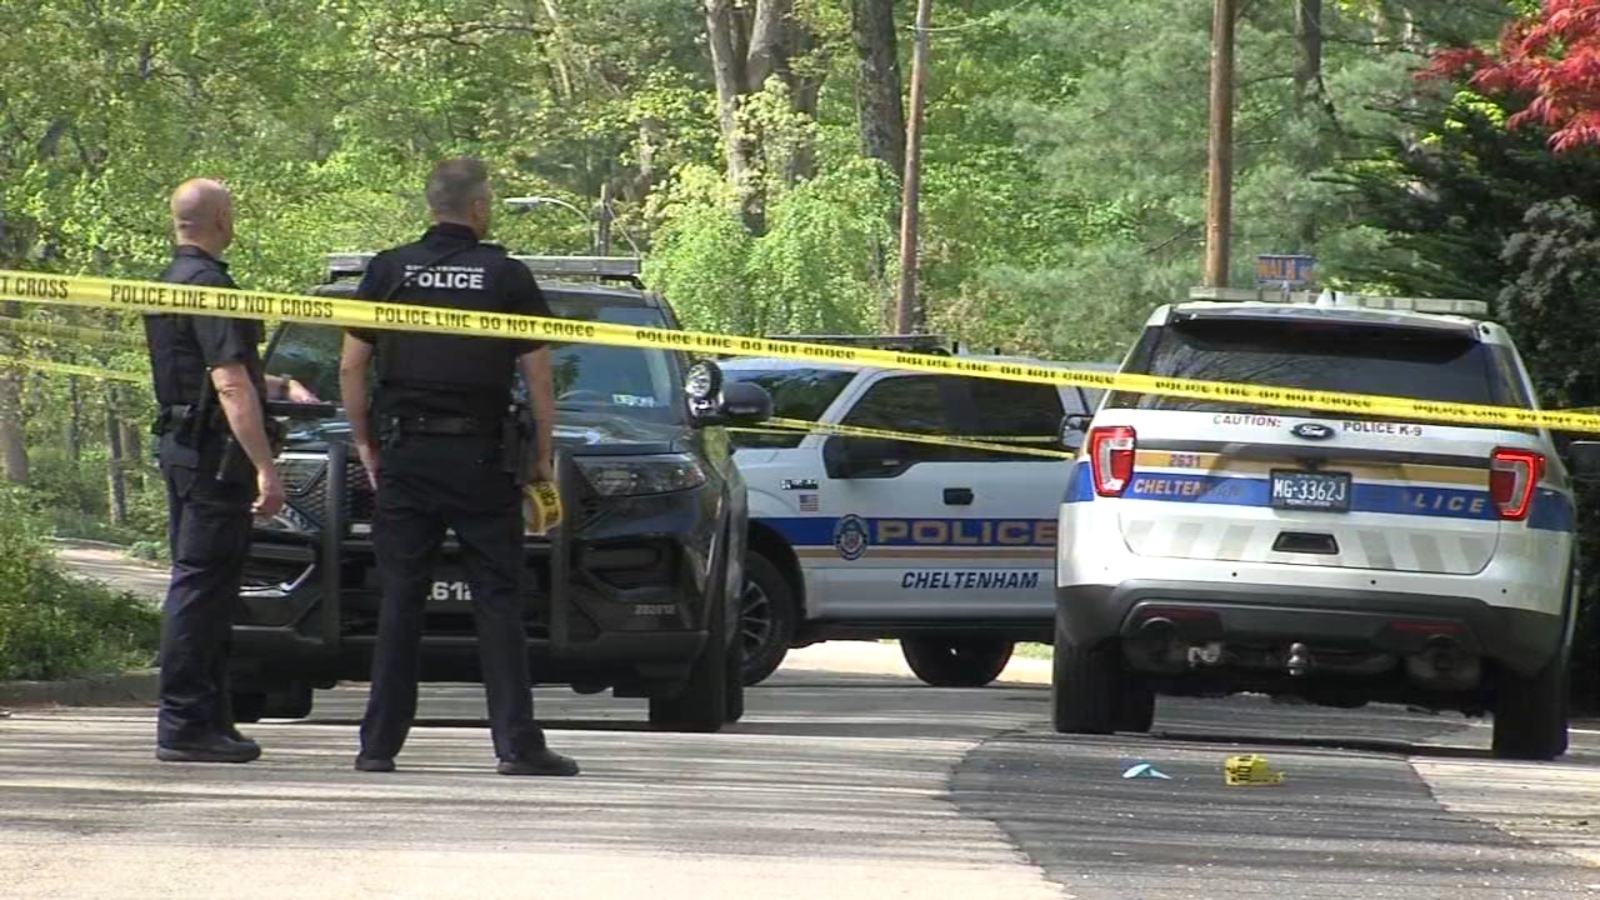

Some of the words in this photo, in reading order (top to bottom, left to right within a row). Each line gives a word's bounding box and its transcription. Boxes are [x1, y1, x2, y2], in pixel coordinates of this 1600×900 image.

[15, 277, 69, 299] CROSS
[111, 284, 166, 305] POLICE
[172, 288, 207, 308] LINE
[216, 293, 239, 311] DO
[244, 295, 276, 313] NOT
[281, 298, 334, 318] CROSS
[375, 306, 430, 325] POLICE
[435, 311, 470, 328] LINE
[480, 317, 501, 329] DO
[506, 318, 537, 333] NOT
[697, 336, 731, 349] LINE
[741, 340, 762, 351] DO
[768, 343, 797, 355] NOT
[1213, 414, 1282, 428] CAUTION:
[1343, 421, 1394, 435] POLICE
[1399, 424, 1423, 437] K-9
[1273, 478, 1346, 501] MG-3362J
[1413, 492, 1487, 514] LICE
[876, 520, 1057, 544] POLICE
[427, 581, 471, 601] 61
[901, 571, 1039, 590] CHELTENHAM
